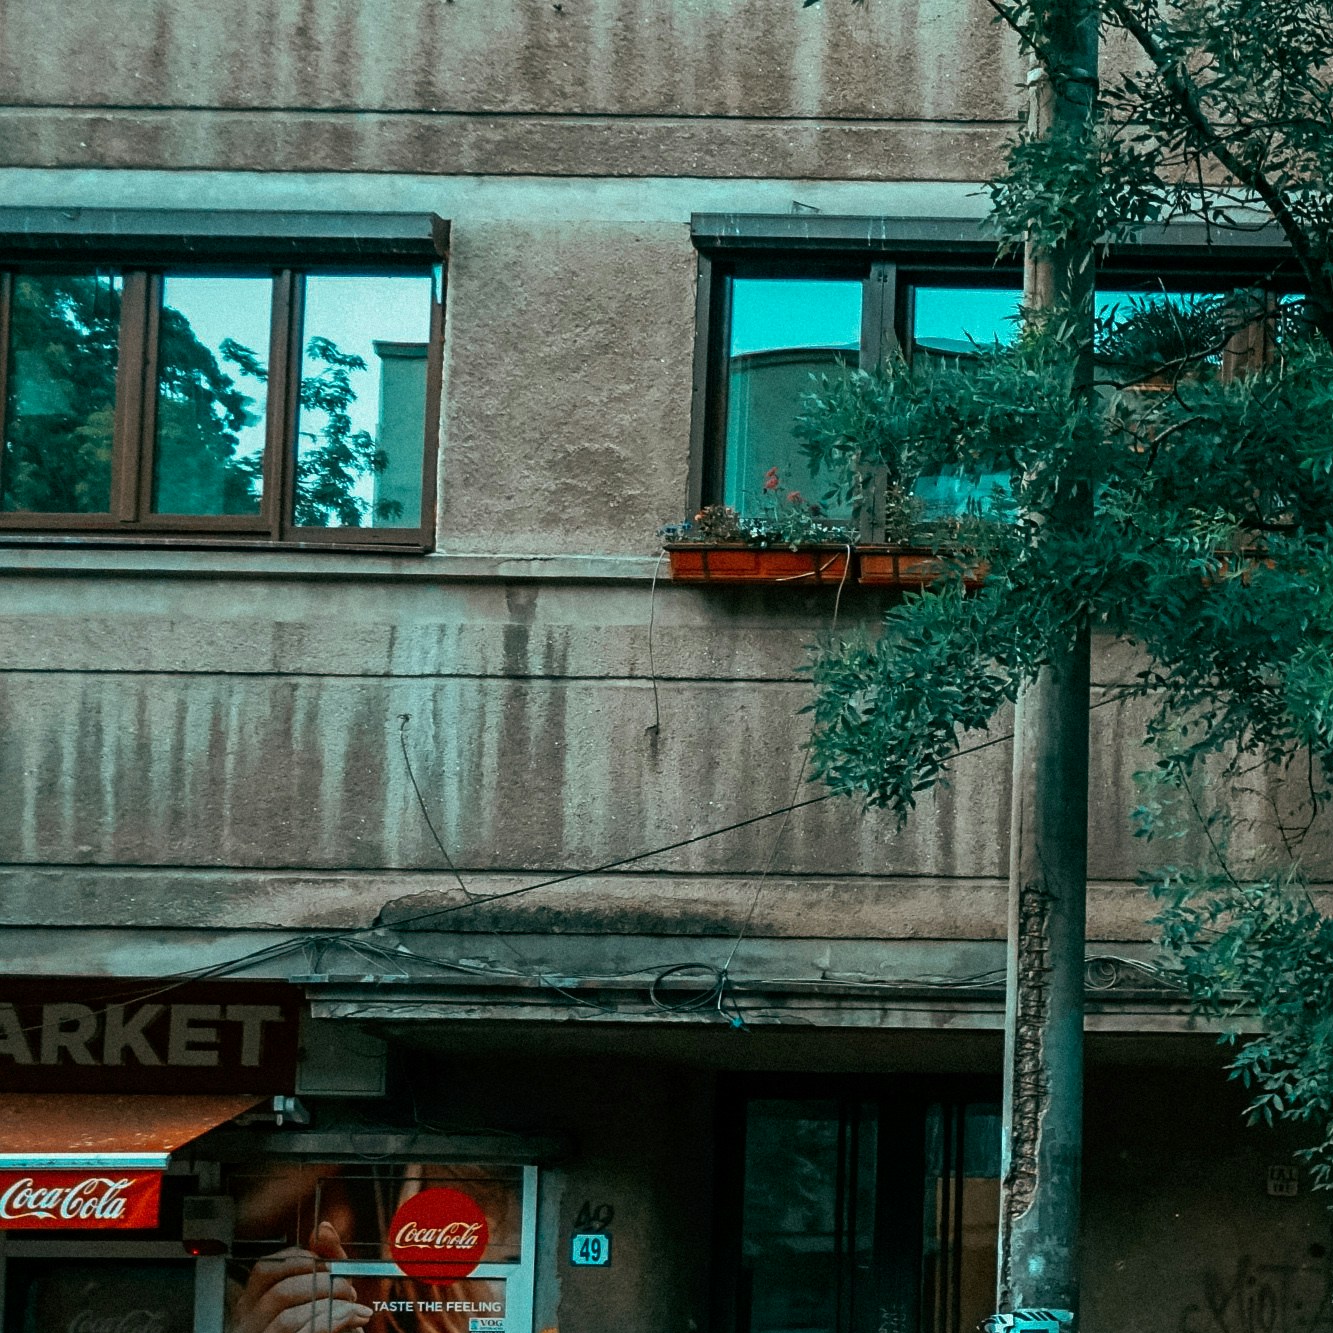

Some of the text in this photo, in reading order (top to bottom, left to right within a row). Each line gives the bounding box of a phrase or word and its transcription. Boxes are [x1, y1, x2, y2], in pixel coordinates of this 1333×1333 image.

[0, 1177, 137, 1220] Coca-Cola
[394, 1221, 484, 1250] Coca-Cola
[580, 1237, 602, 1262] 49
[372, 1301, 502, 1313] TASTE THE FEELING
